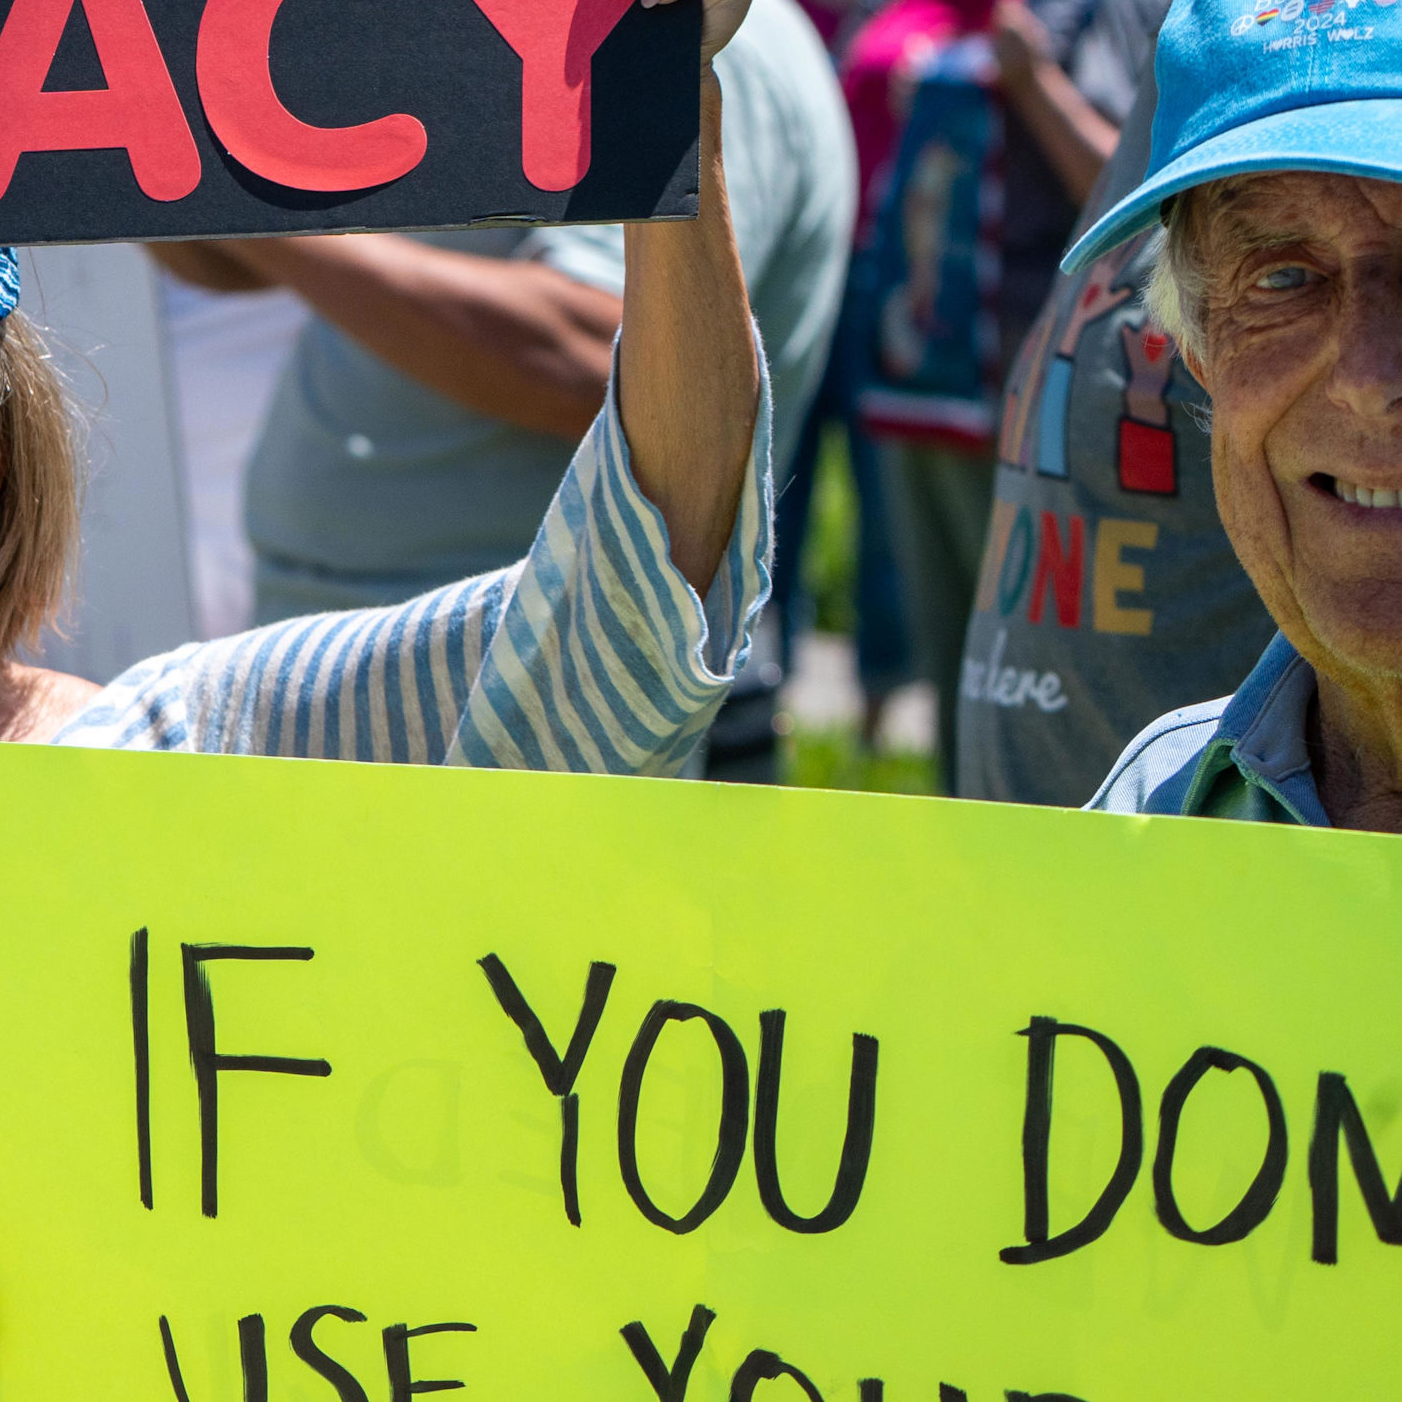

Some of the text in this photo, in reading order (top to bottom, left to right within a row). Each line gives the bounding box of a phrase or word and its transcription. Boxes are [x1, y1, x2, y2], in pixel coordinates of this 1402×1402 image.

[1293, 10, 1347, 35] 2024
[128, 925, 334, 1220] IF
[475, 951, 880, 1236] YOU
[998, 1014, 1402, 1266] DON
